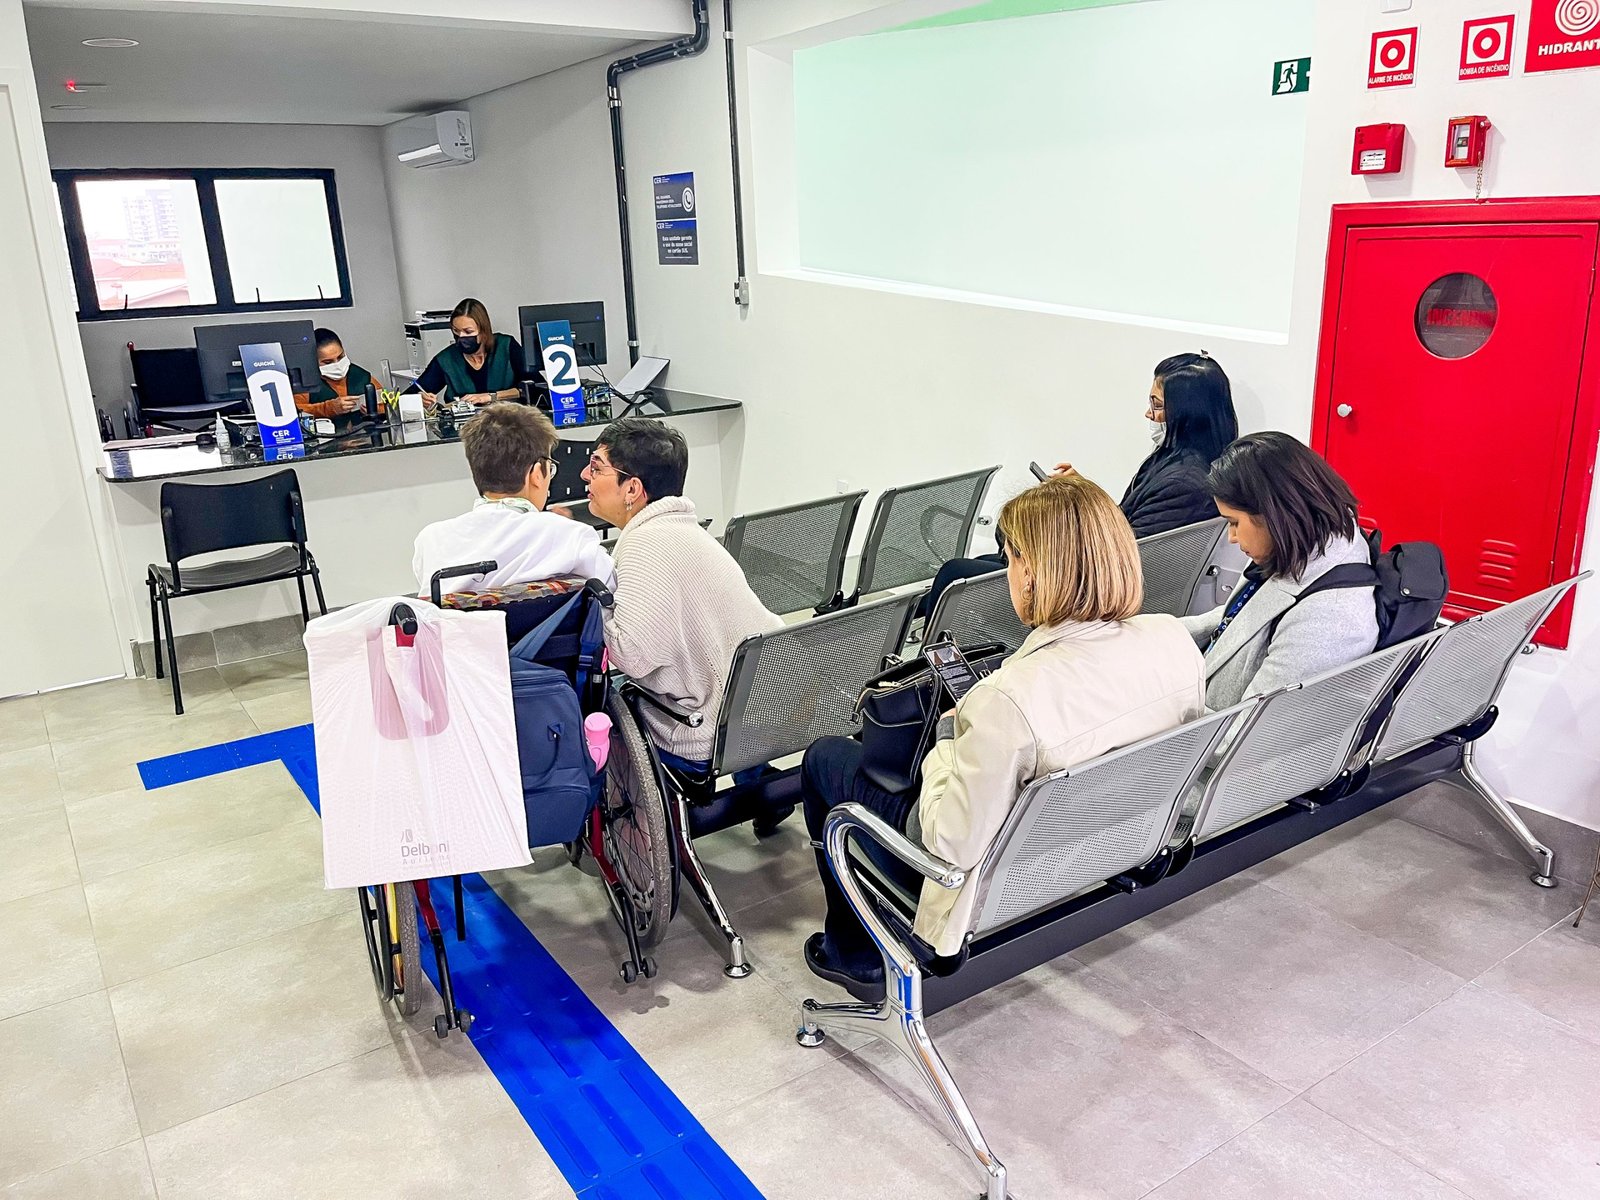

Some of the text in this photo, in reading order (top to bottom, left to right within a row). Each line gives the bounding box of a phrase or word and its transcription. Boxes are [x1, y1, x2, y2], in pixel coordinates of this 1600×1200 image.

[1369, 76, 1386, 84] ALARME
[1386, 75, 1393, 83] DE
[1460, 63, 1510, 76] BOMBA DE INCÊNDIO
[549, 351, 576, 386] 2
[260, 382, 283, 417] 1
